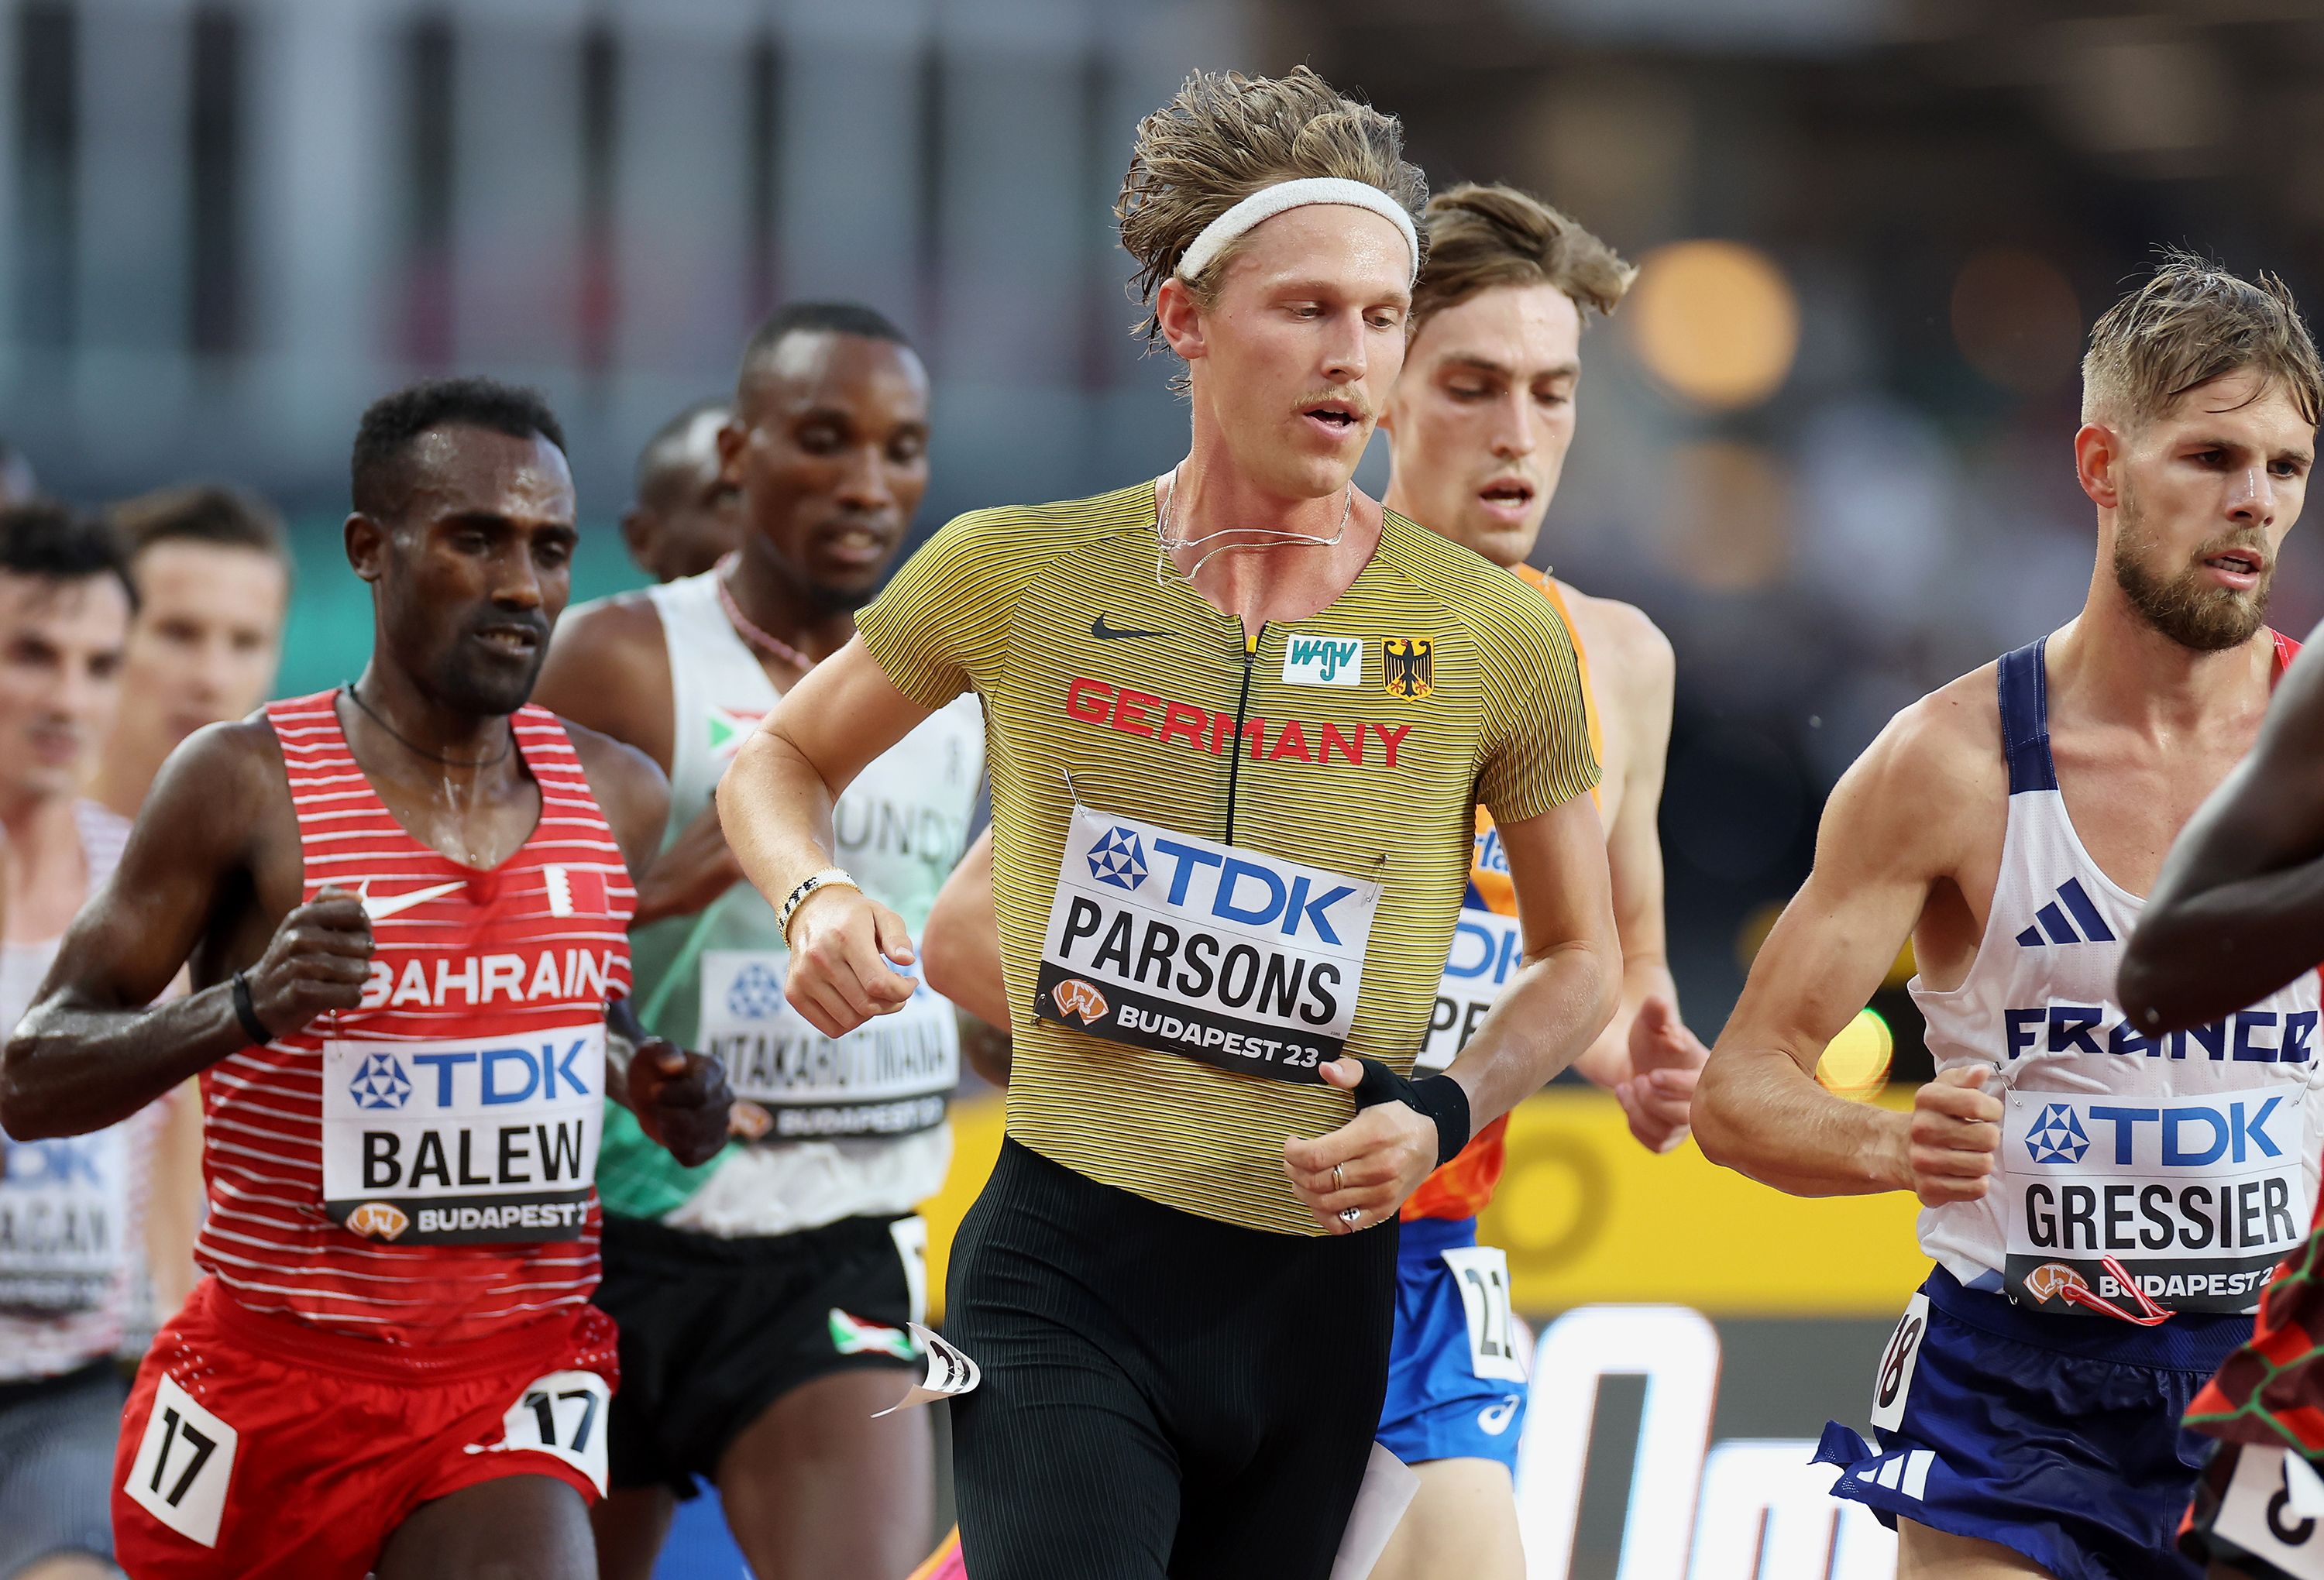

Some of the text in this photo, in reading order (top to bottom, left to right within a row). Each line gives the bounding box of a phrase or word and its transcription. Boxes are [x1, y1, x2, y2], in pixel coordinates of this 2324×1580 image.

[1065, 677, 1412, 768] GERMANY
[1153, 838, 1356, 946] TDK
[359, 949, 612, 1008] BAHRAIN
[1059, 895, 1340, 1025] PARSONS
[1117, 1005, 1318, 1069] BUDAPEST 23
[413, 1039, 590, 1108] TDK
[363, 1120, 583, 1189] BALEW
[2089, 1096, 2283, 1166] TDK
[418, 1203, 576, 1232] BUDAPEST
[2025, 1177, 2298, 1250] GRESSIER
[2259, 1266, 2274, 1287] 2
[1875, 1314, 1923, 1409] 18
[524, 1389, 599, 1454] 17
[150, 1406, 218, 1508] 17
